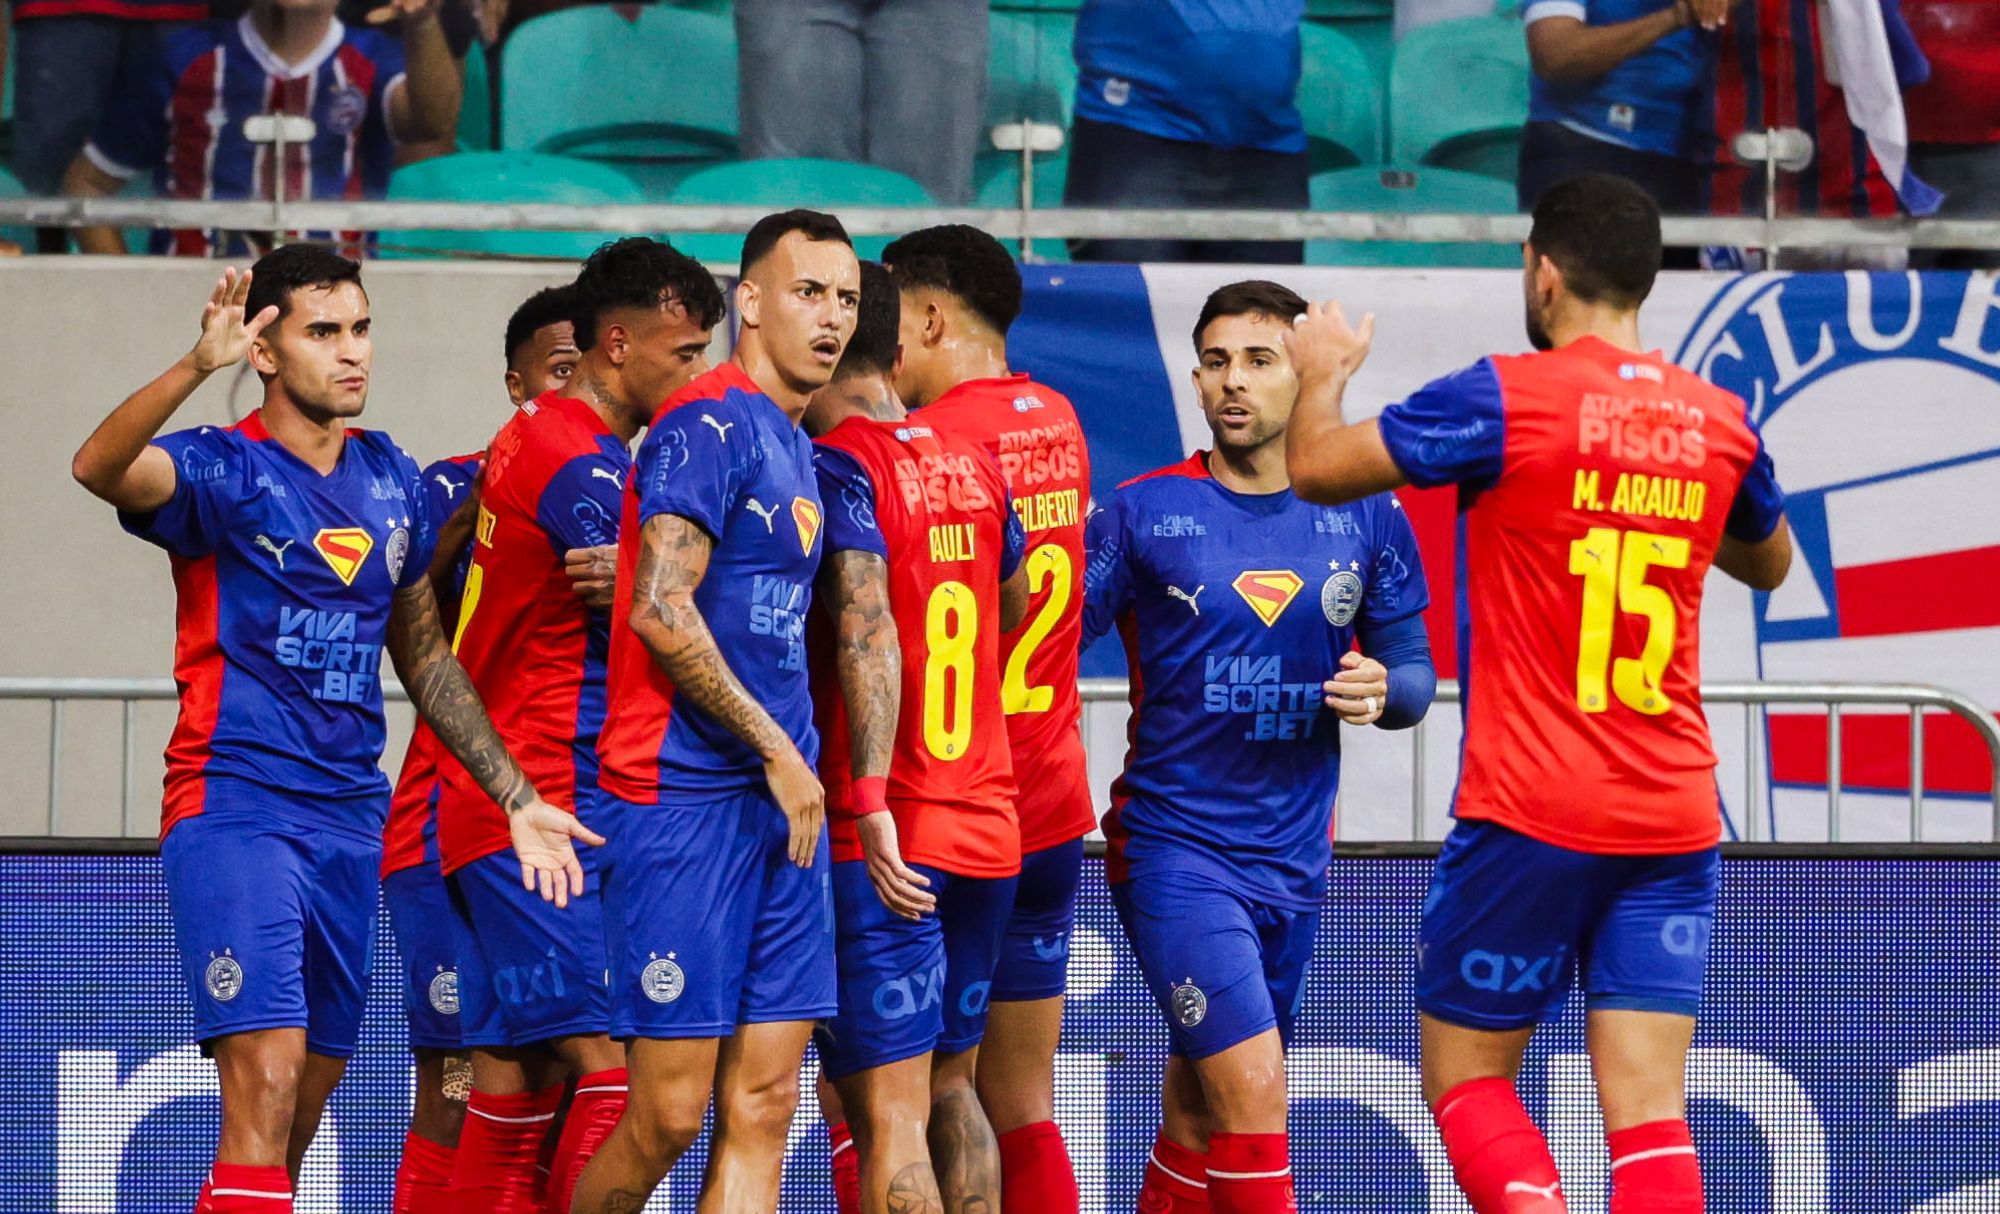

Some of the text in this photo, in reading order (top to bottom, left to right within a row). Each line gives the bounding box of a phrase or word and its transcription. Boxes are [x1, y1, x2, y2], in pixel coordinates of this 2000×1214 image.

[999, 444, 1080, 488] PISOS
[1578, 418, 1707, 469] PISOS
[1012, 488, 1079, 532] GILBERTO
[1573, 469, 1706, 522] M. ARAUJO
[279, 606, 356, 641] VIVA
[1002, 544, 1071, 715] 2
[1569, 527, 1690, 716] 15
[923, 581, 978, 761] 8
[1205, 655, 1281, 684] VIVA
[1204, 683, 1321, 713] SORTE
[1245, 712, 1317, 740] .BET
[1460, 944, 1566, 993] axi
